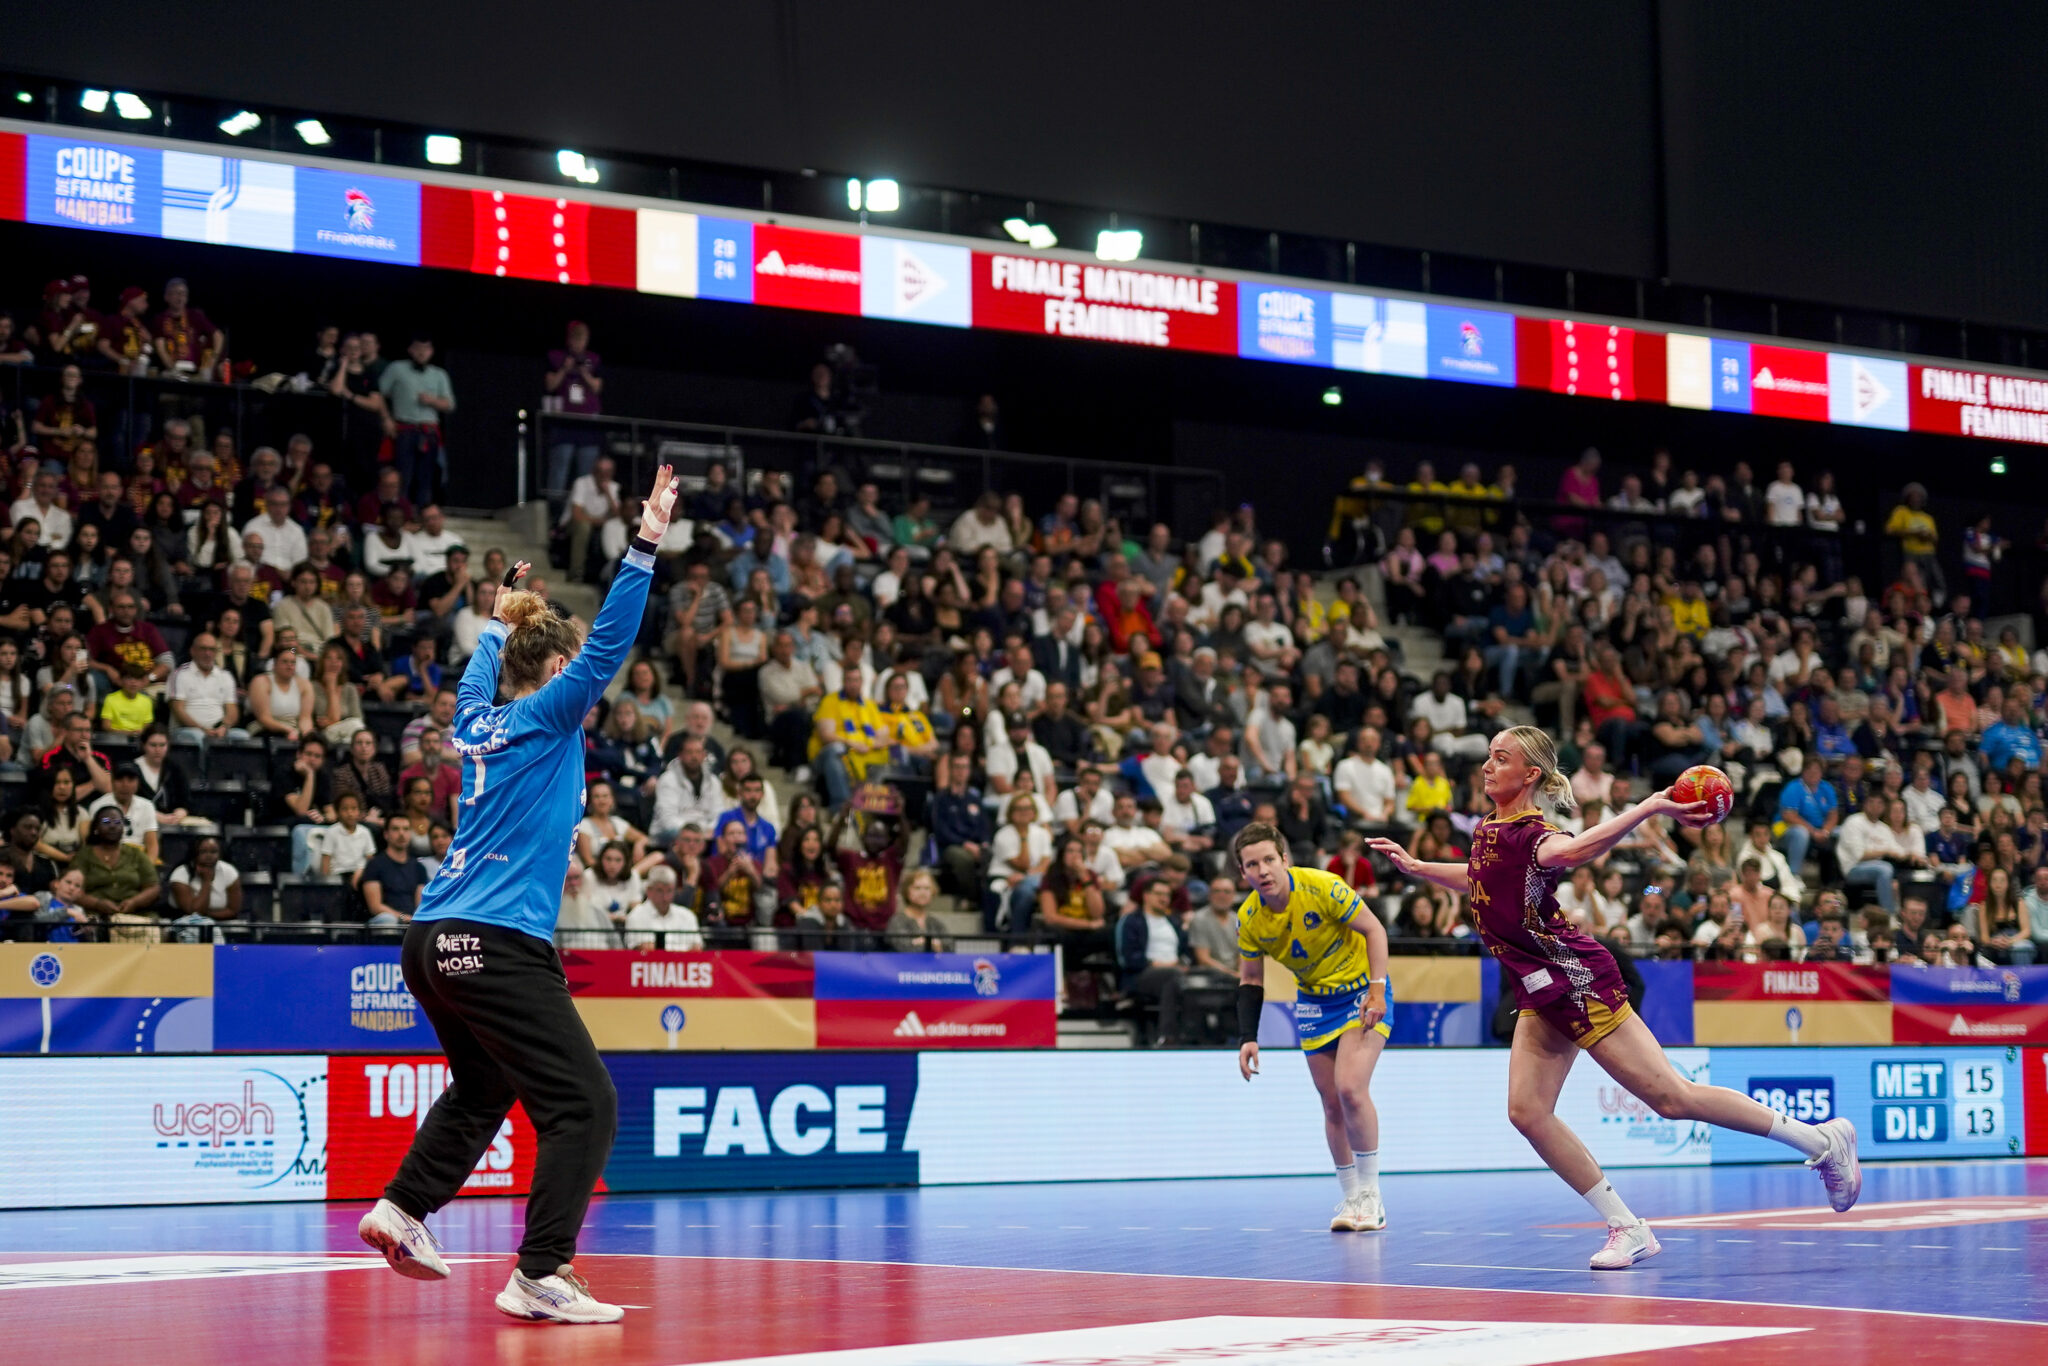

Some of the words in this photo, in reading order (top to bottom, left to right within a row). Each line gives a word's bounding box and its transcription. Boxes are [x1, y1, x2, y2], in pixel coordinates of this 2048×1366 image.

[57, 147, 136, 183] COUPE
[70, 178, 136, 204] FRANCE
[55, 197, 136, 225] HANDBALL
[714, 238, 736, 258] 20
[714, 260, 736, 280] 24
[992, 255, 1081, 298] FINALE
[1084, 266, 1219, 315] NATIONALE
[1045, 296, 1169, 346] FÉMININE
[1922, 367, 1987, 405] FINALE
[439, 937, 481, 952] METZ
[1291, 938, 1309, 959] 4
[351, 963, 410, 992] COUP
[631, 961, 713, 988] FINALES
[1763, 971, 1820, 994] FINALES
[364, 992, 416, 1009] FRANCE
[351, 1010, 416, 1032] HANDBALL
[925, 1021, 969, 1037] adidas
[970, 1023, 1007, 1037] arena
[364, 1063, 454, 1118] TOU
[1876, 1063, 1944, 1098] MET
[1966, 1066, 1994, 1094] 15
[154, 1080, 274, 1148] ucph
[654, 1085, 888, 1157] FACE
[1885, 1106, 1937, 1140] DIJ
[1967, 1107, 1996, 1135] 13
